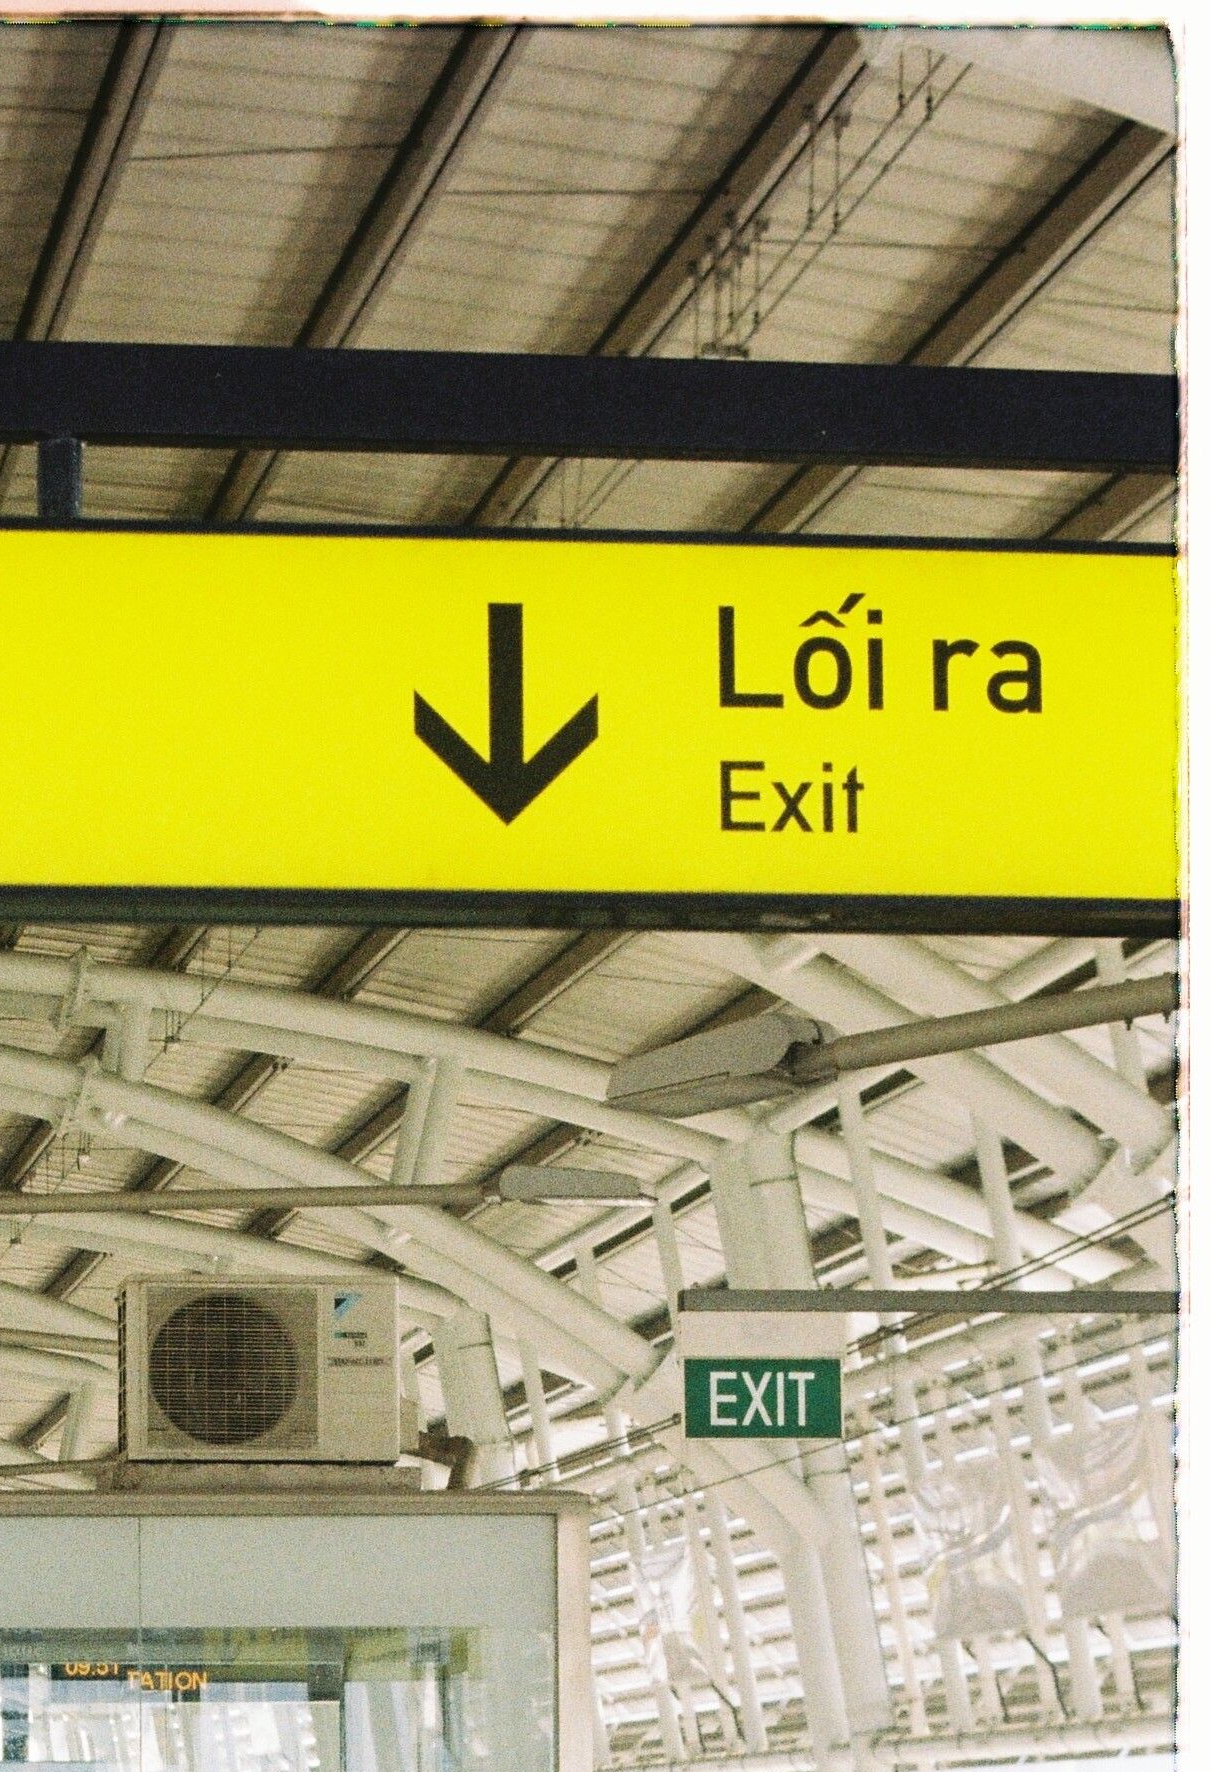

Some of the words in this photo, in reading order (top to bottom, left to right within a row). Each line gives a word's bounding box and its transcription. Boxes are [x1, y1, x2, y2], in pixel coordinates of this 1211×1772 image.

[719, 593, 884, 711] Lối
[933, 638, 1042, 713] ra
[720, 761, 864, 833] Exit
[709, 1371, 815, 1426] EXIT
